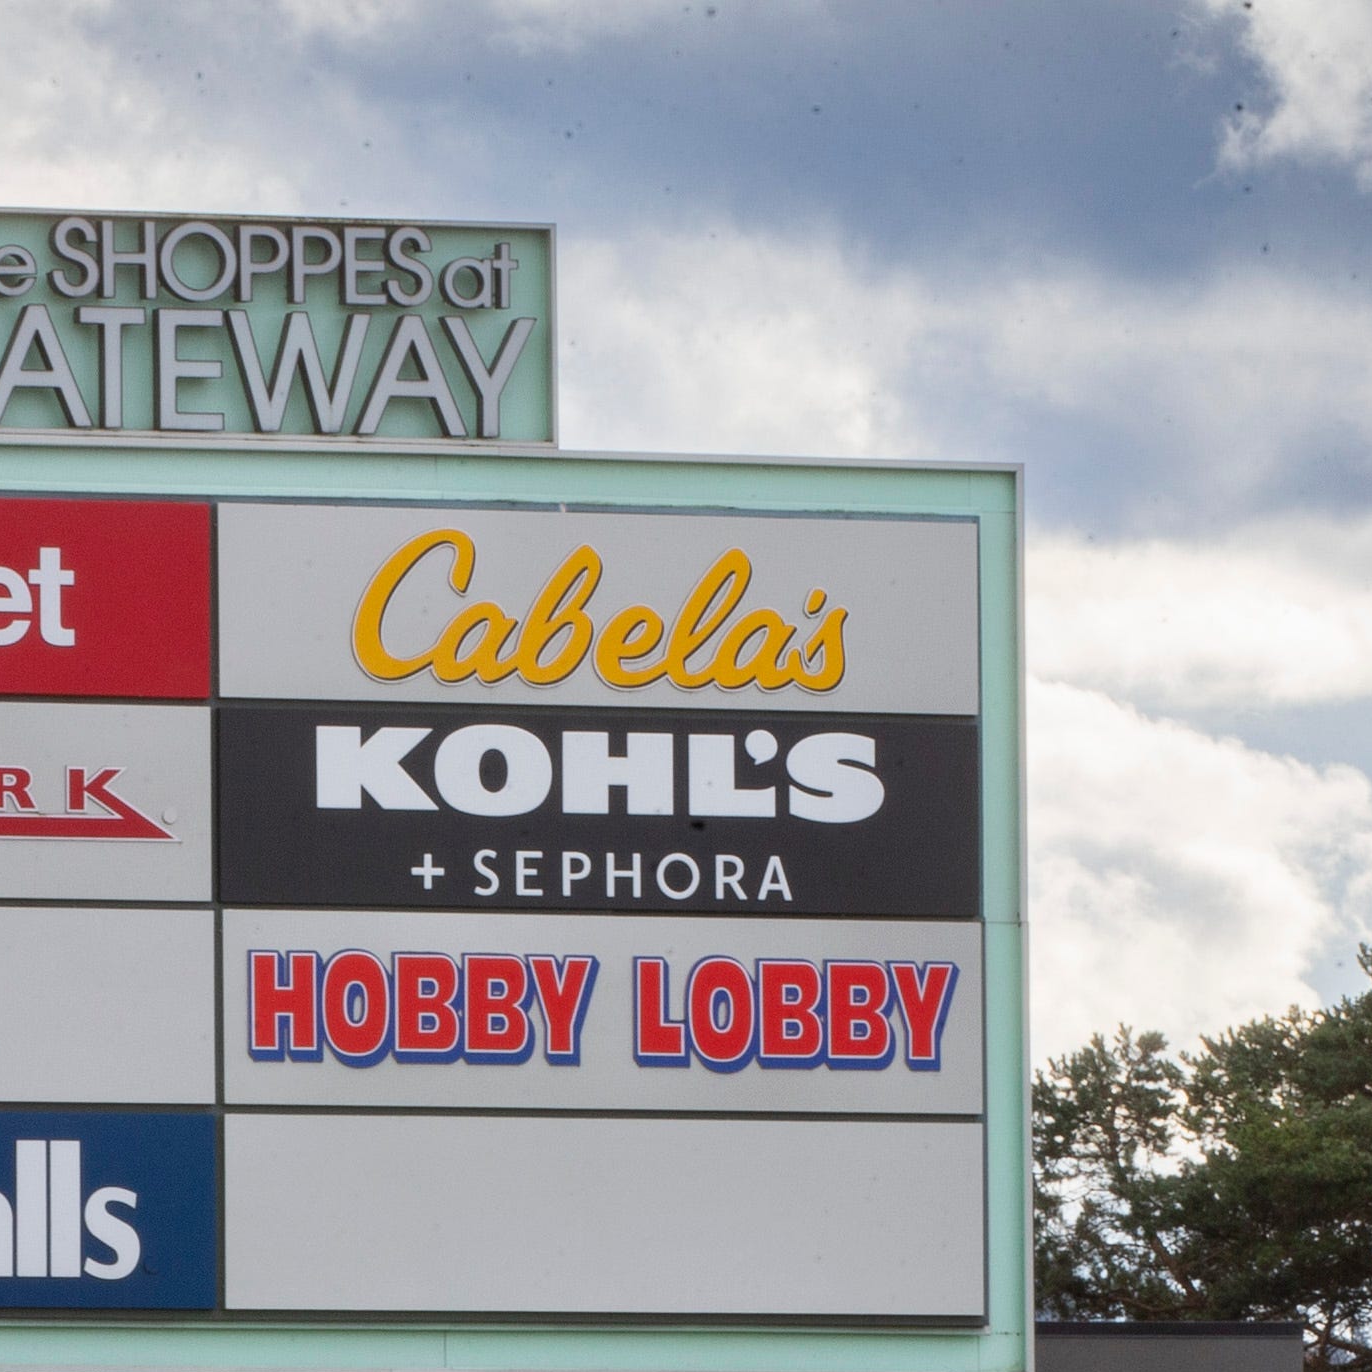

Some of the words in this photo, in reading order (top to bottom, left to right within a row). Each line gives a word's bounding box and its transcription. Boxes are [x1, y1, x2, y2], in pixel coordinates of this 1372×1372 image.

[47, 216, 433, 308] SHOPPES
[440, 242, 518, 308] at
[351, 528, 849, 694] Cabela's
[315, 723, 886, 824] KOHL'S
[473, 849, 793, 902] SEPHORA
[247, 949, 599, 1069] HOBBY
[632, 955, 960, 1074] LOBBY
